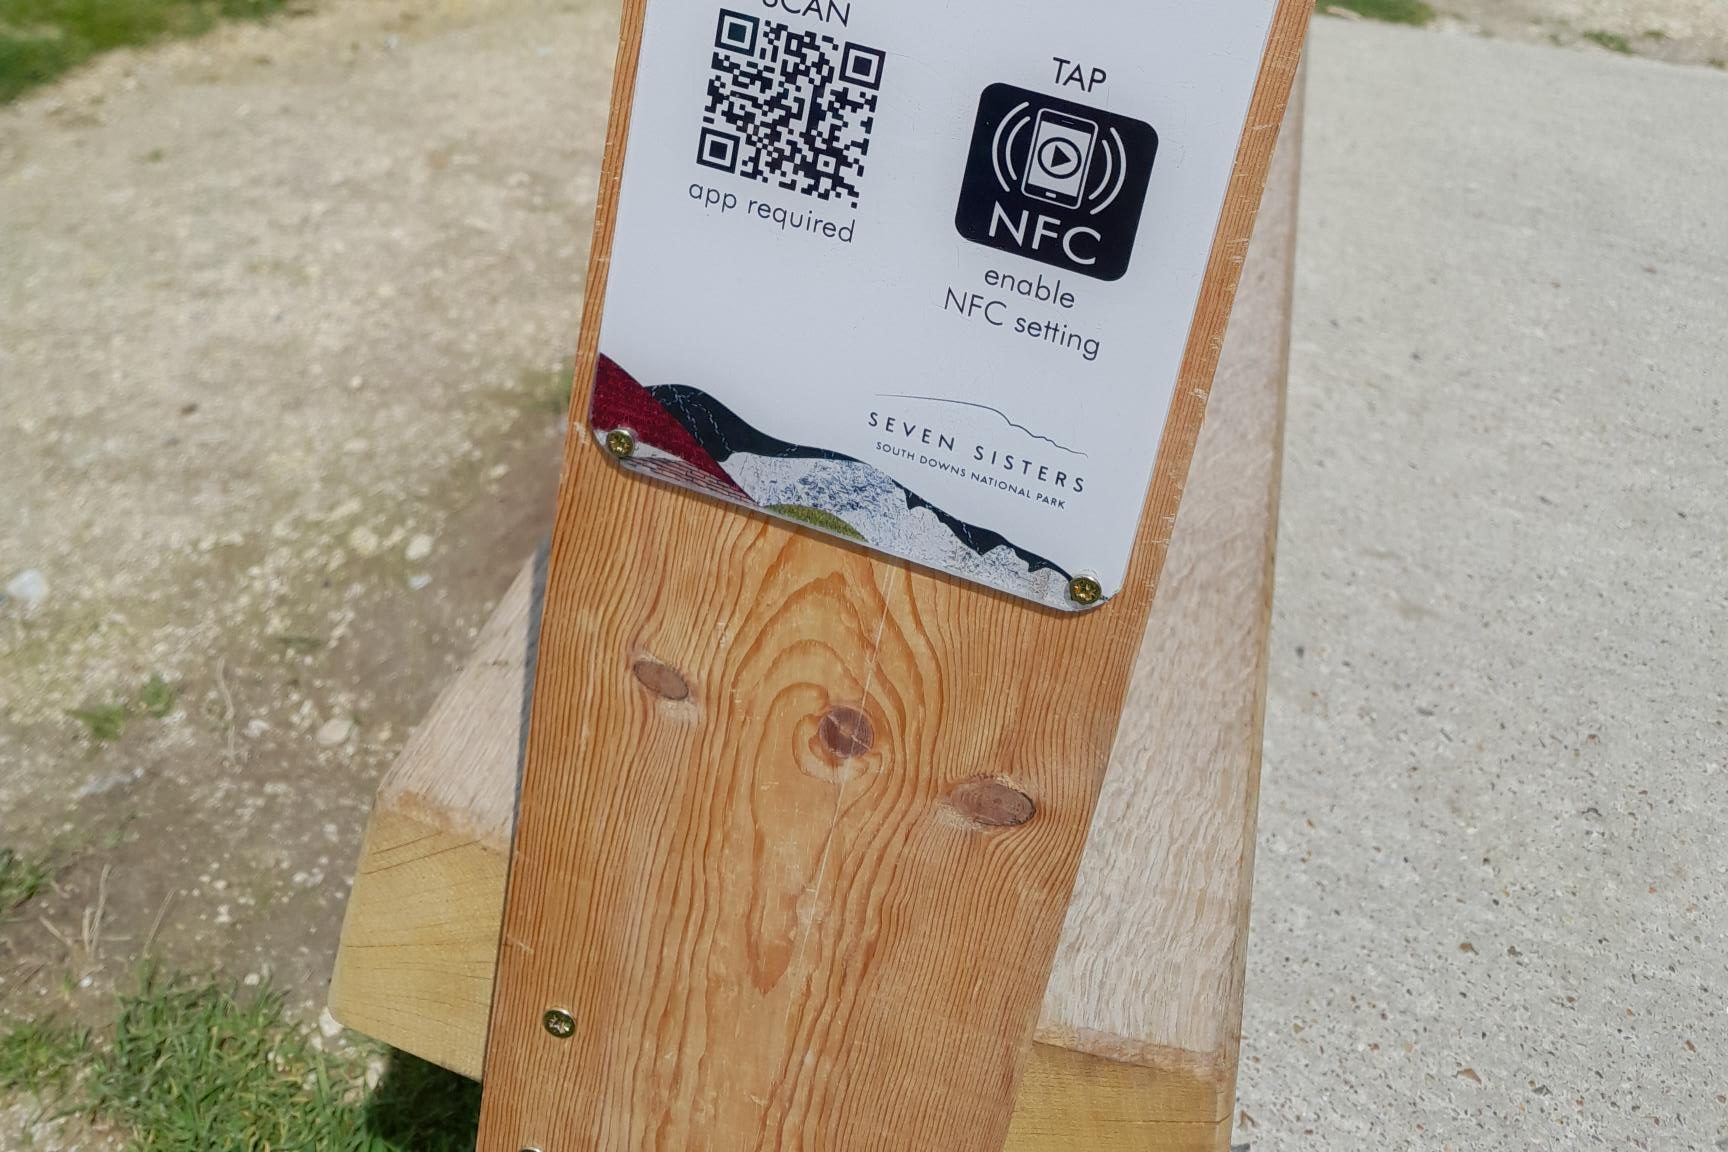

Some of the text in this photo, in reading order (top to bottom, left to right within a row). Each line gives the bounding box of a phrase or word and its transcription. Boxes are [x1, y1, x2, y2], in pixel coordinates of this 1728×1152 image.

[1052, 56, 1107, 93] TAP
[688, 183, 856, 244] app required
[988, 200, 1101, 265] NFC
[984, 269, 1075, 309] enable
[944, 286, 1100, 362] NFC setting
[868, 411, 1084, 493] SEVEN SISTERS
[875, 441, 1066, 510] SOUTH DOWNS NATIONAL PARK
